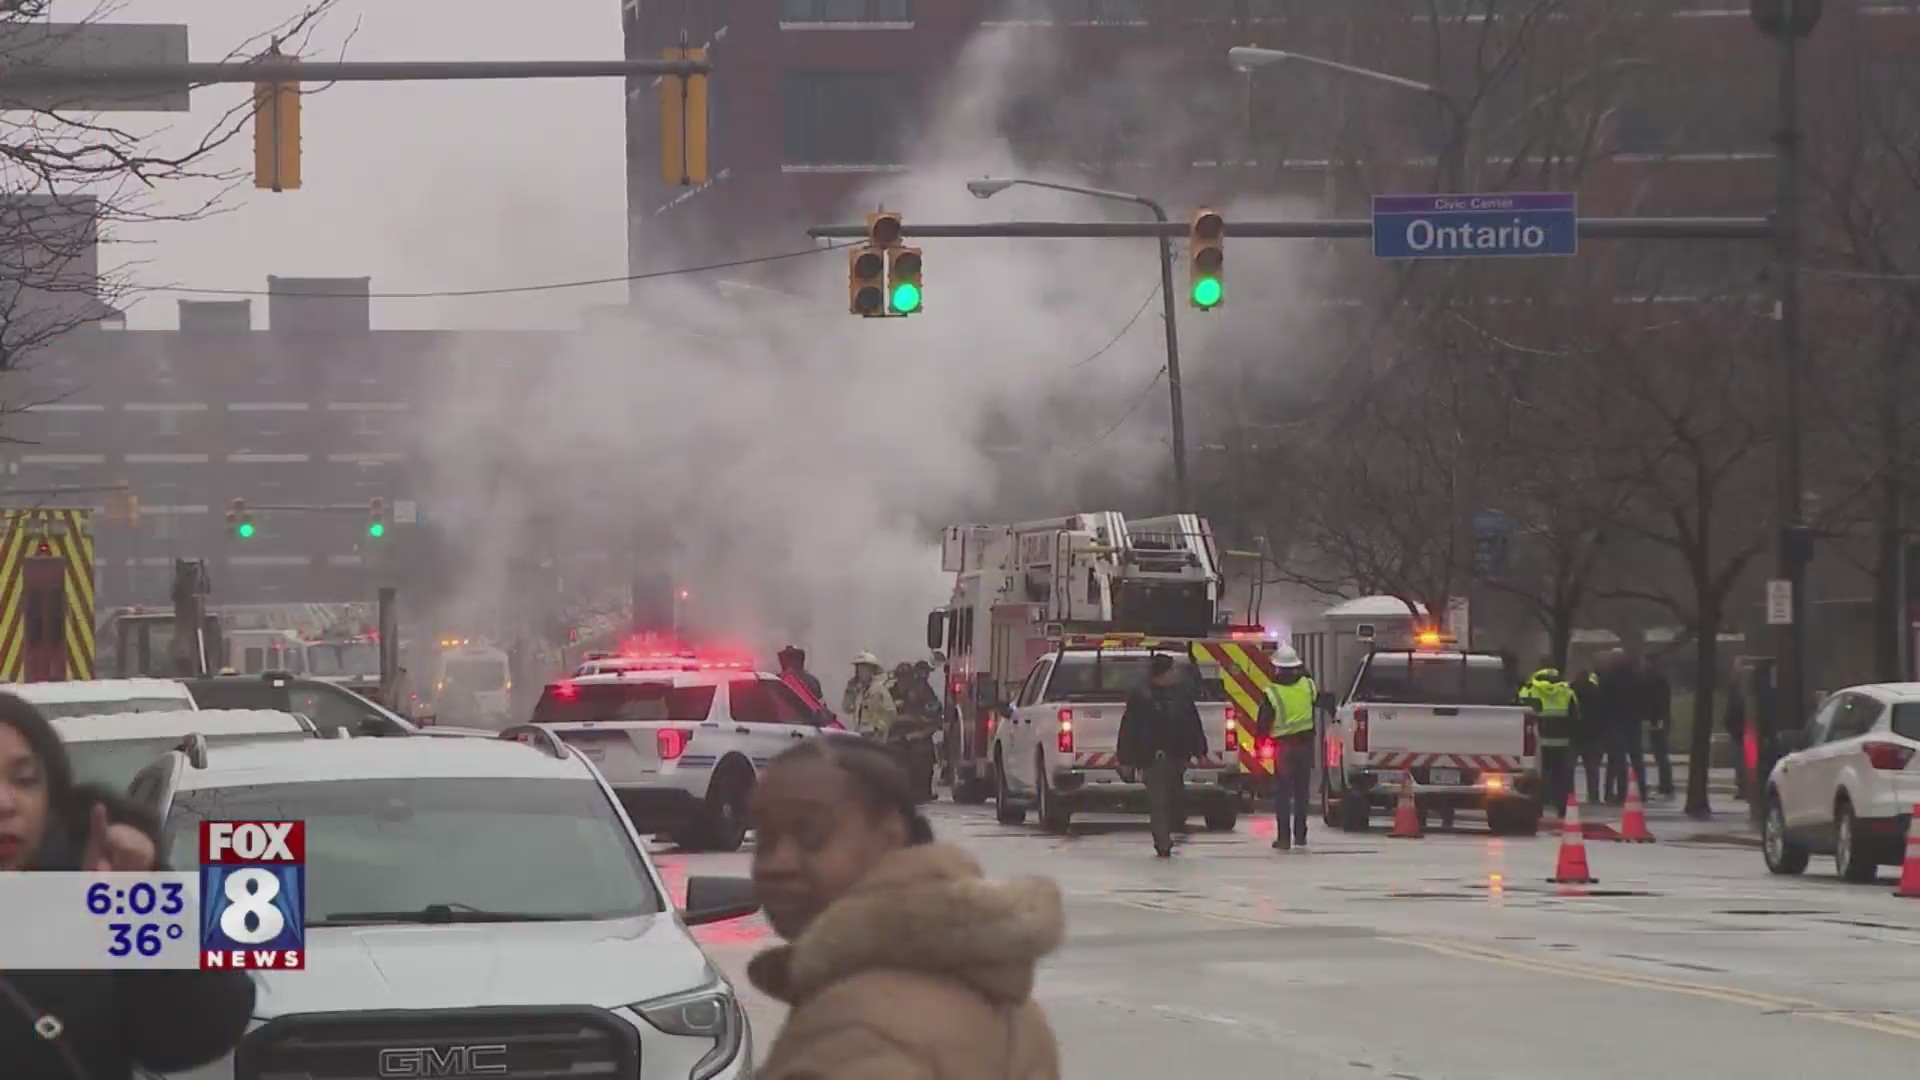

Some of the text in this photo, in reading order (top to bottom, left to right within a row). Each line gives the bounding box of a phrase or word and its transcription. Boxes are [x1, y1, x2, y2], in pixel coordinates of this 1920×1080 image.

[1434, 198, 1514, 210] Civic Center
[1406, 217, 1545, 250] Ontario
[378, 1044, 507, 1077] GMC
